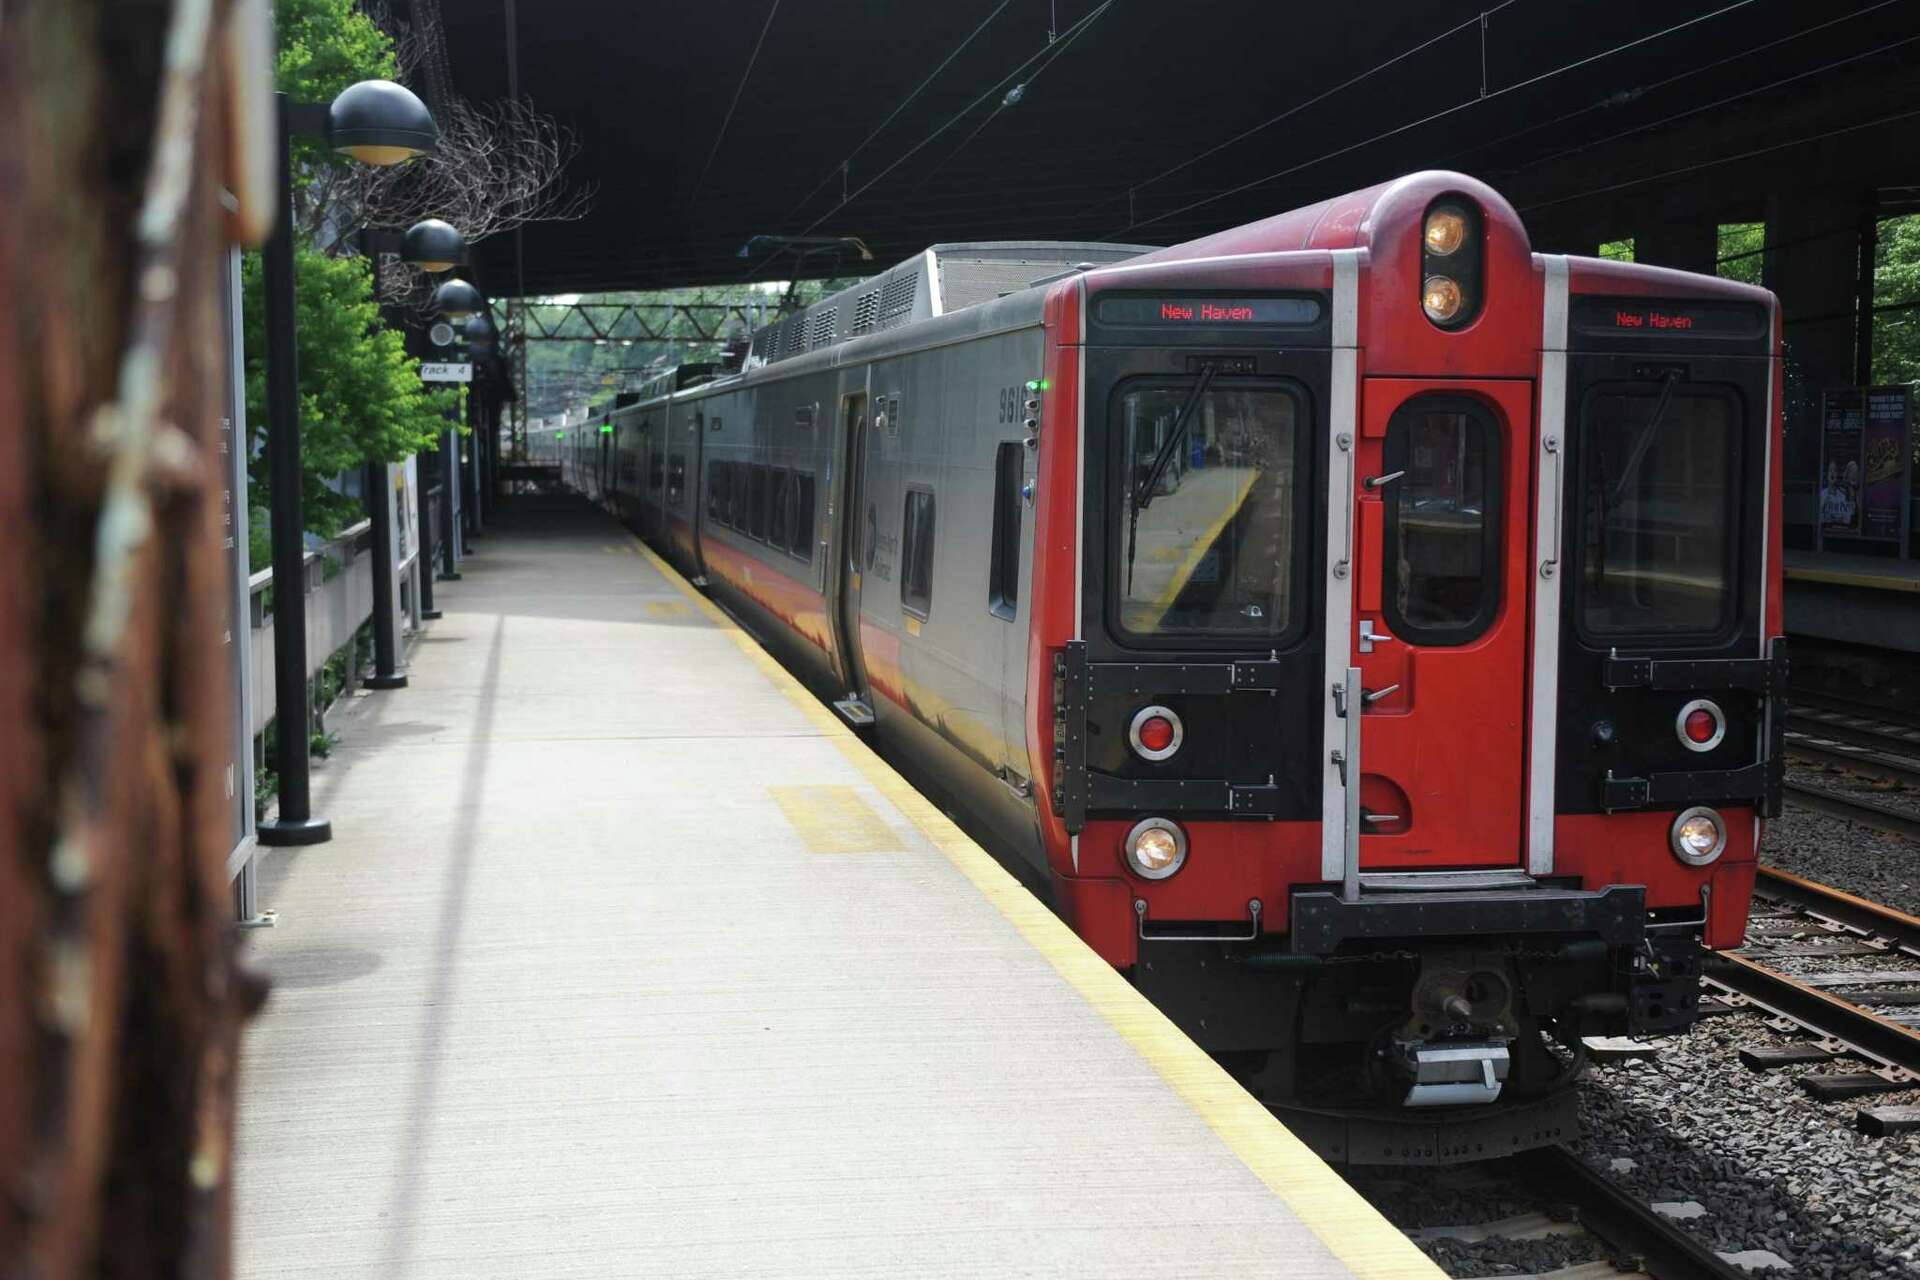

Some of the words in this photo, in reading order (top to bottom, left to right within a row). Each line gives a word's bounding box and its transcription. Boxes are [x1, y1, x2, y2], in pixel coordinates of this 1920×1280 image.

[1162, 303, 1192, 320] New
[1201, 303, 1253, 321] Haven
[1616, 311, 1643, 327] New
[1649, 311, 1692, 329] Haven
[422, 364, 448, 375] rack
